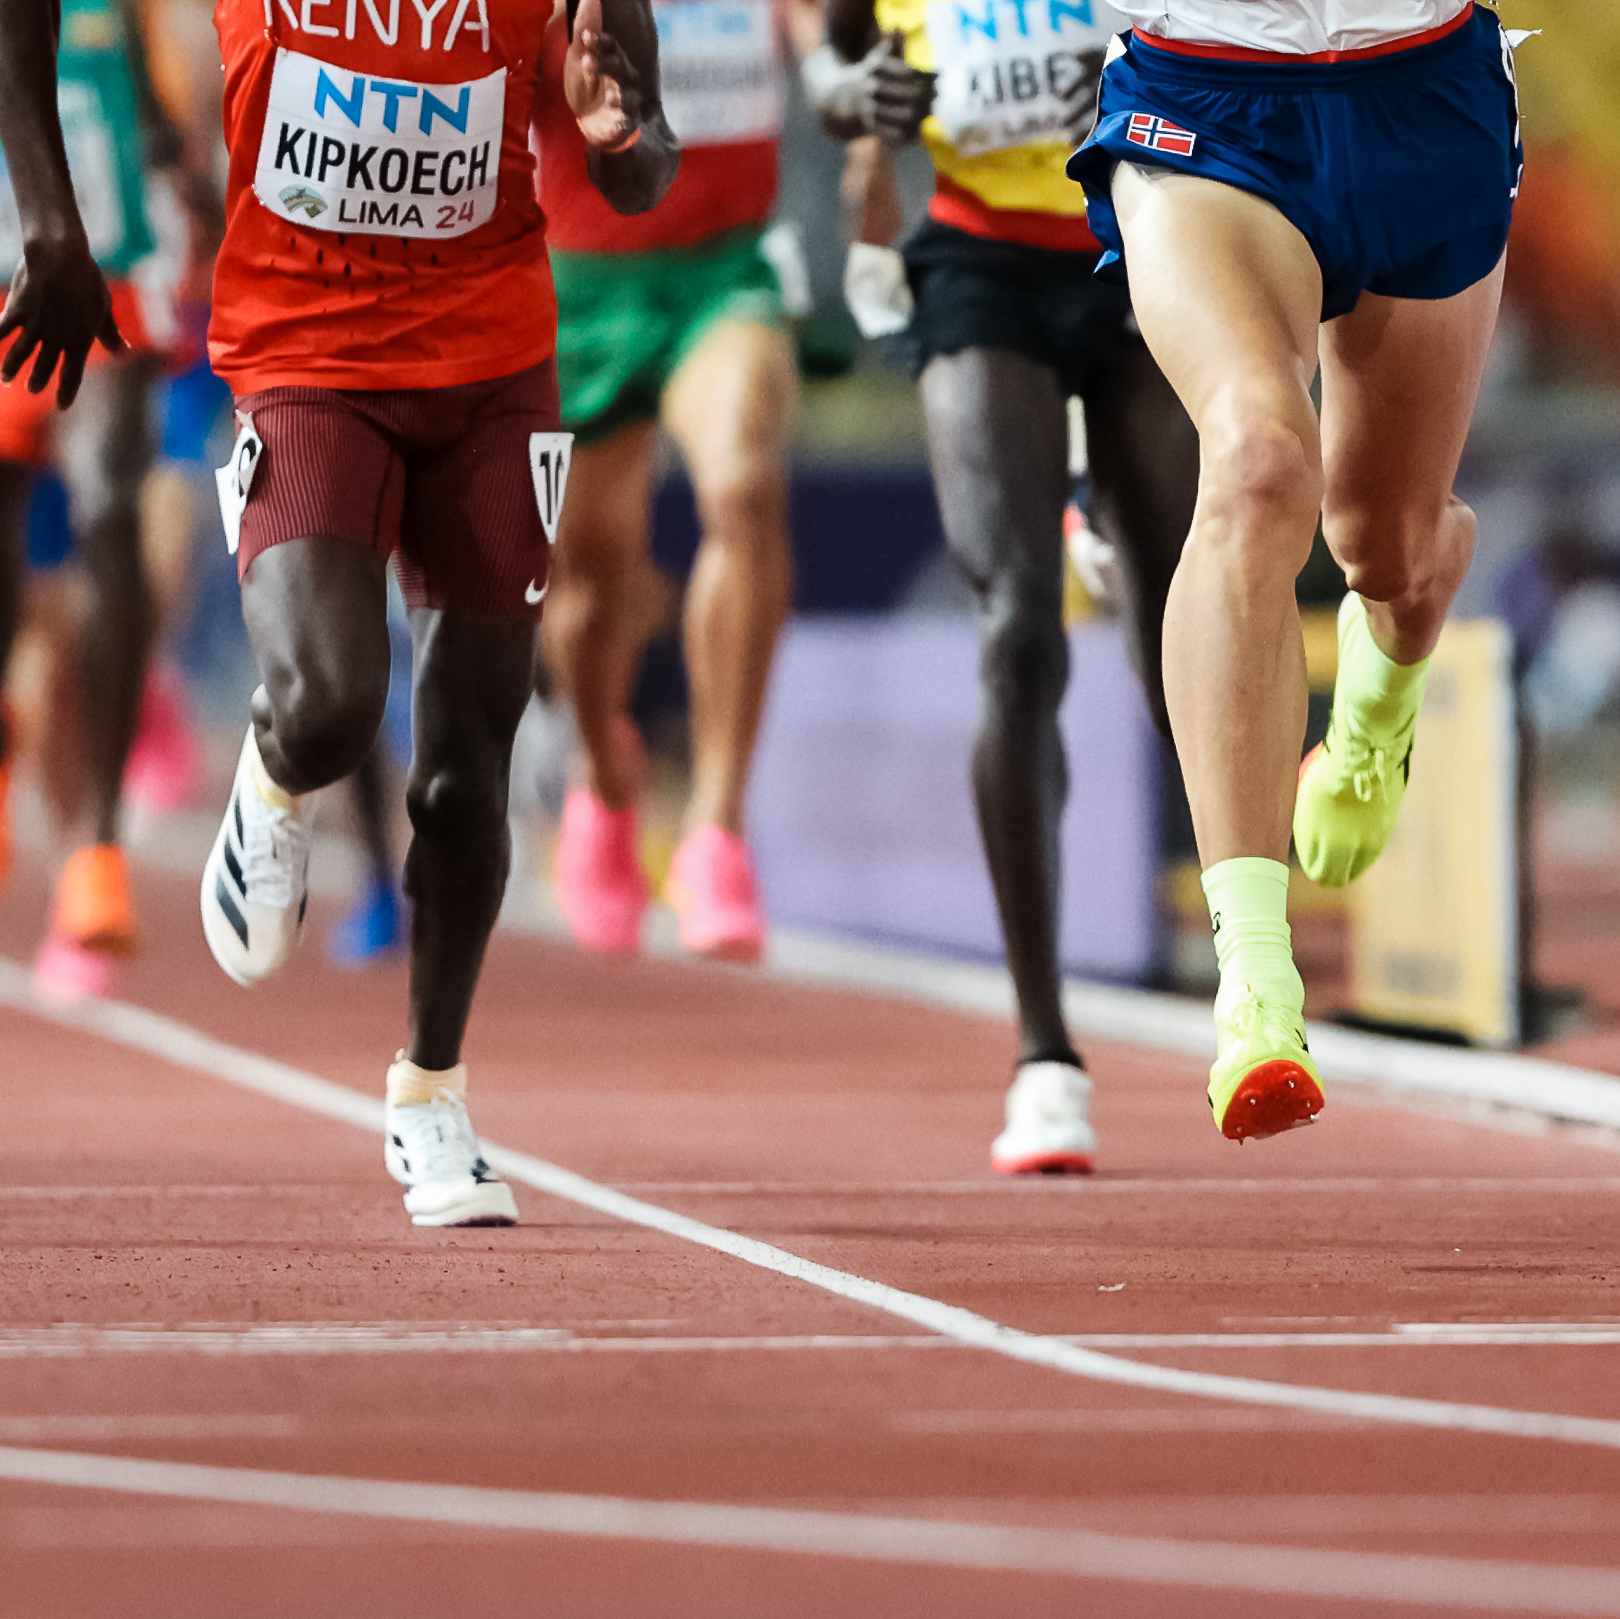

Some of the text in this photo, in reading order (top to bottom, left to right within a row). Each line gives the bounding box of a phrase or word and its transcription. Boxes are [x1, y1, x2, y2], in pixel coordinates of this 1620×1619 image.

[313, 65, 472, 137] NTN
[274, 122, 491, 196] KIPKOECH
[337, 198, 475, 230] LIMA 24
